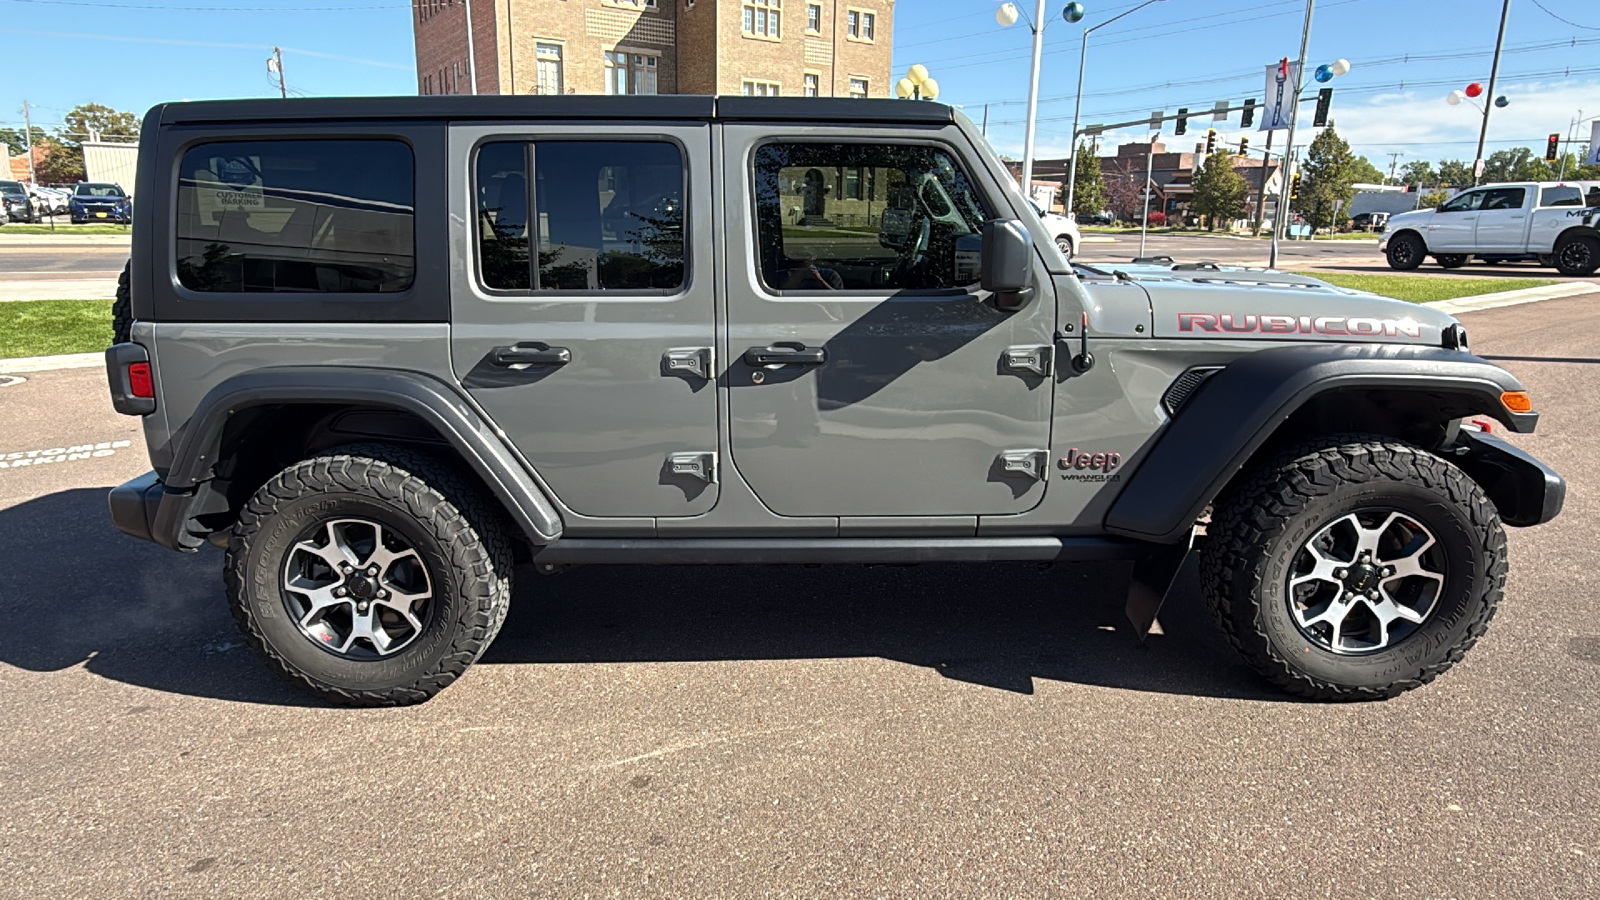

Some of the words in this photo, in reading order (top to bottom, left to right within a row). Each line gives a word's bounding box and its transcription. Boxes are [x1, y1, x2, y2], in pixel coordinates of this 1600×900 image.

[216, 191, 263, 199] CUSTOMER
[221, 198, 260, 206] PARKING
[1177, 312, 1421, 338] RUBICON
[0, 440, 131, 461] STOMER
[1058, 447, 1122, 473] Jeep
[1269, 513, 1319, 659] BFGoodrich
